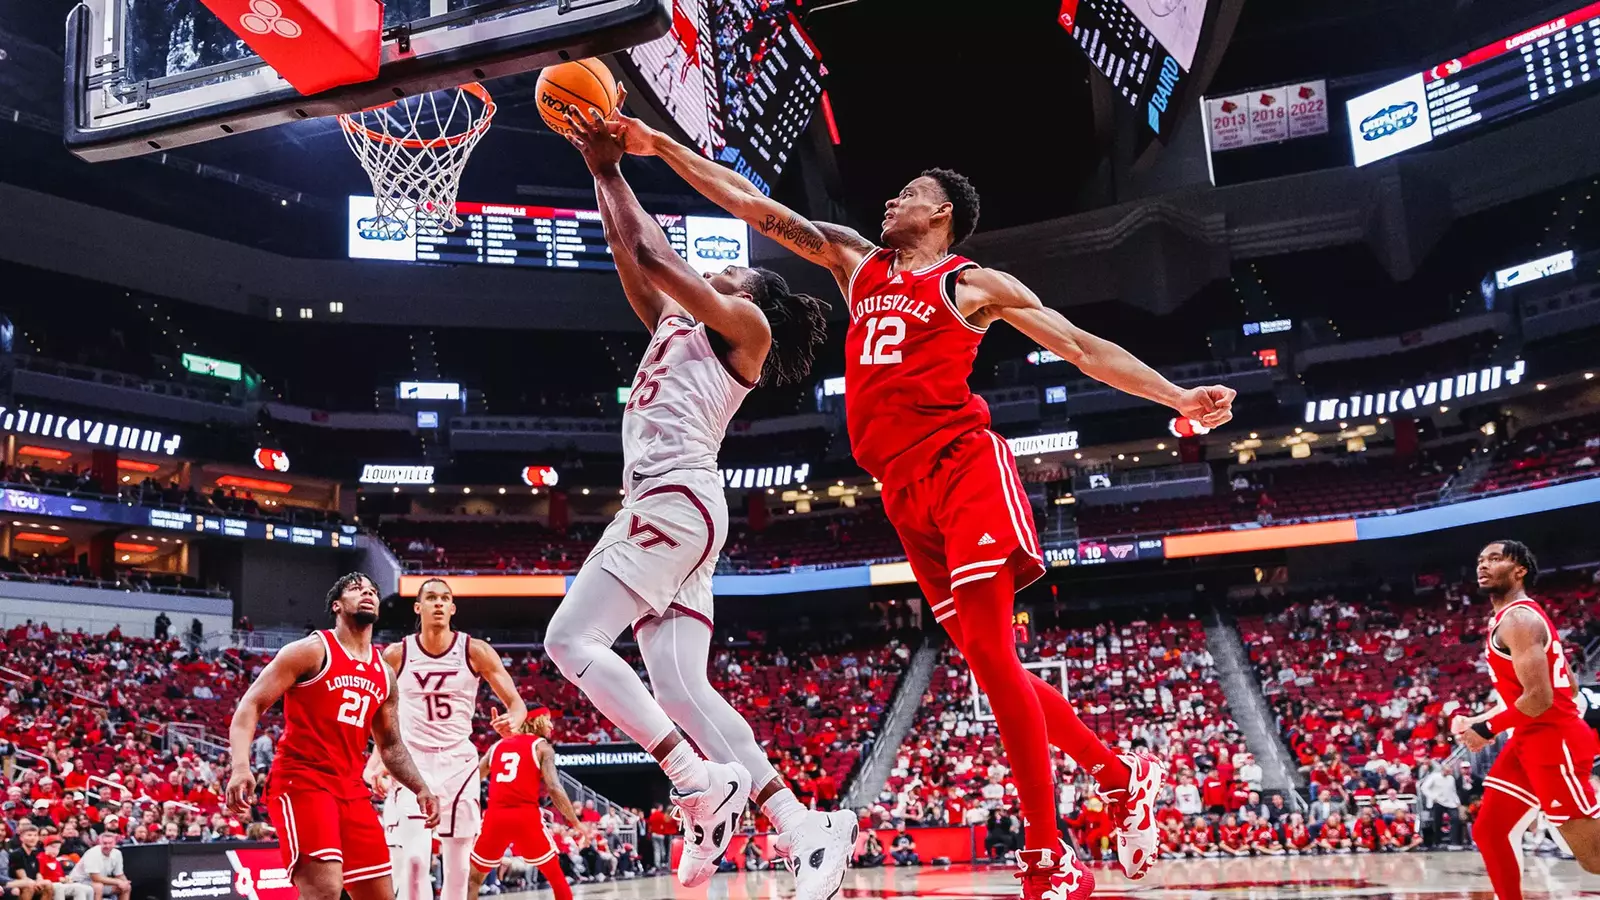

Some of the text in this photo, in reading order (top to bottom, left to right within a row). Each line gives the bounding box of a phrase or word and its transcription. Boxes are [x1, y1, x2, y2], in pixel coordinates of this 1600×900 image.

[696, 0, 727, 149] OUISVILLE
[1151, 56, 1179, 113] BAIRD
[1252, 107, 1284, 123] 2018
[1290, 99, 1324, 117] 2022
[1213, 113, 1246, 130] 2013
[850, 294, 936, 325] LOUISVILLE
[860, 316, 906, 365] 12
[626, 366, 669, 413] 25
[1010, 431, 1079, 456] OUISVILLE
[360, 464, 435, 485] LOUISVILLE
[9, 493, 40, 510] YOU
[1045, 548, 1075, 562] 11:19
[1085, 546, 1102, 559] 10
[412, 671, 459, 691] VT
[337, 689, 371, 729] 21
[424, 694, 453, 722] 15
[496, 752, 521, 783] 3
[596, 751, 658, 765] HEALTHCA
